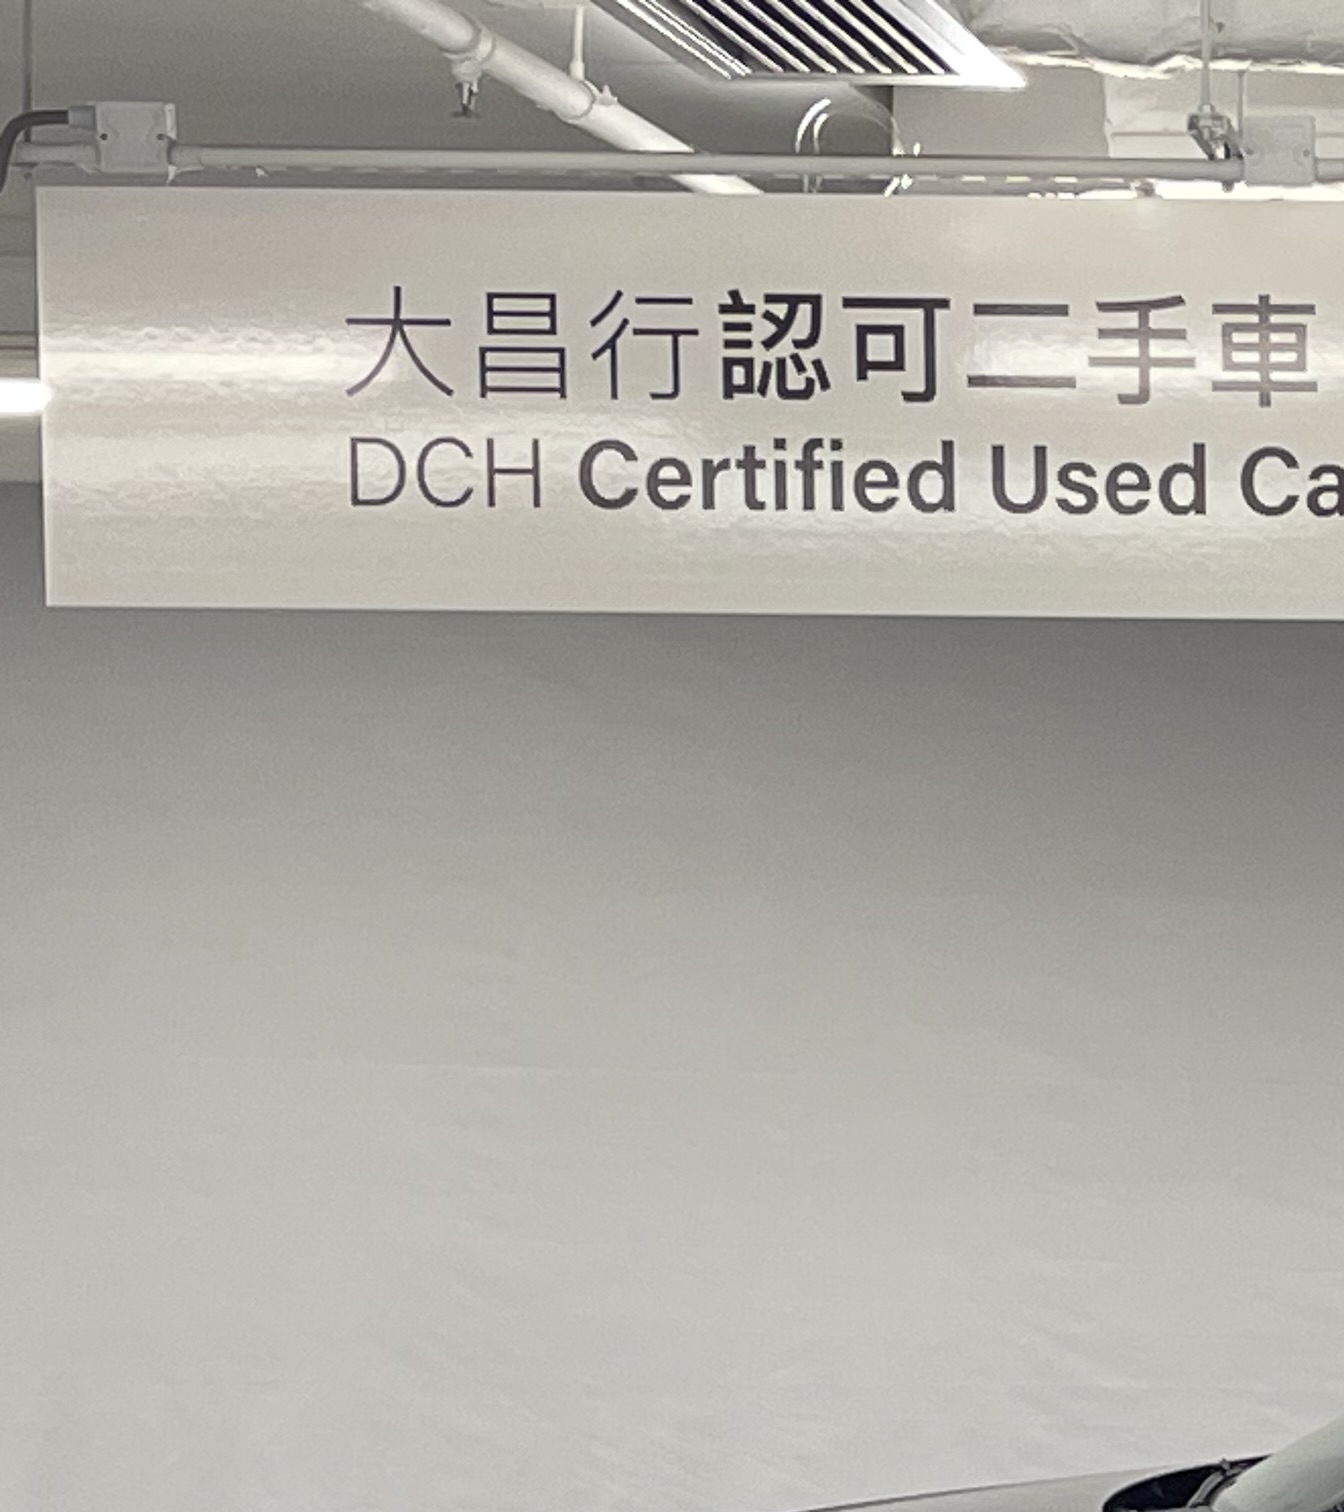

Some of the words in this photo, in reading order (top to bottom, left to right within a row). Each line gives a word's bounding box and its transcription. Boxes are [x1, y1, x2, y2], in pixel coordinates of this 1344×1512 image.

[345, 286, 1319, 408] 大昌行認可二手車
[350, 436, 541, 509] DCH
[578, 437, 957, 515] Certified
[990, 441, 1208, 517] Used
